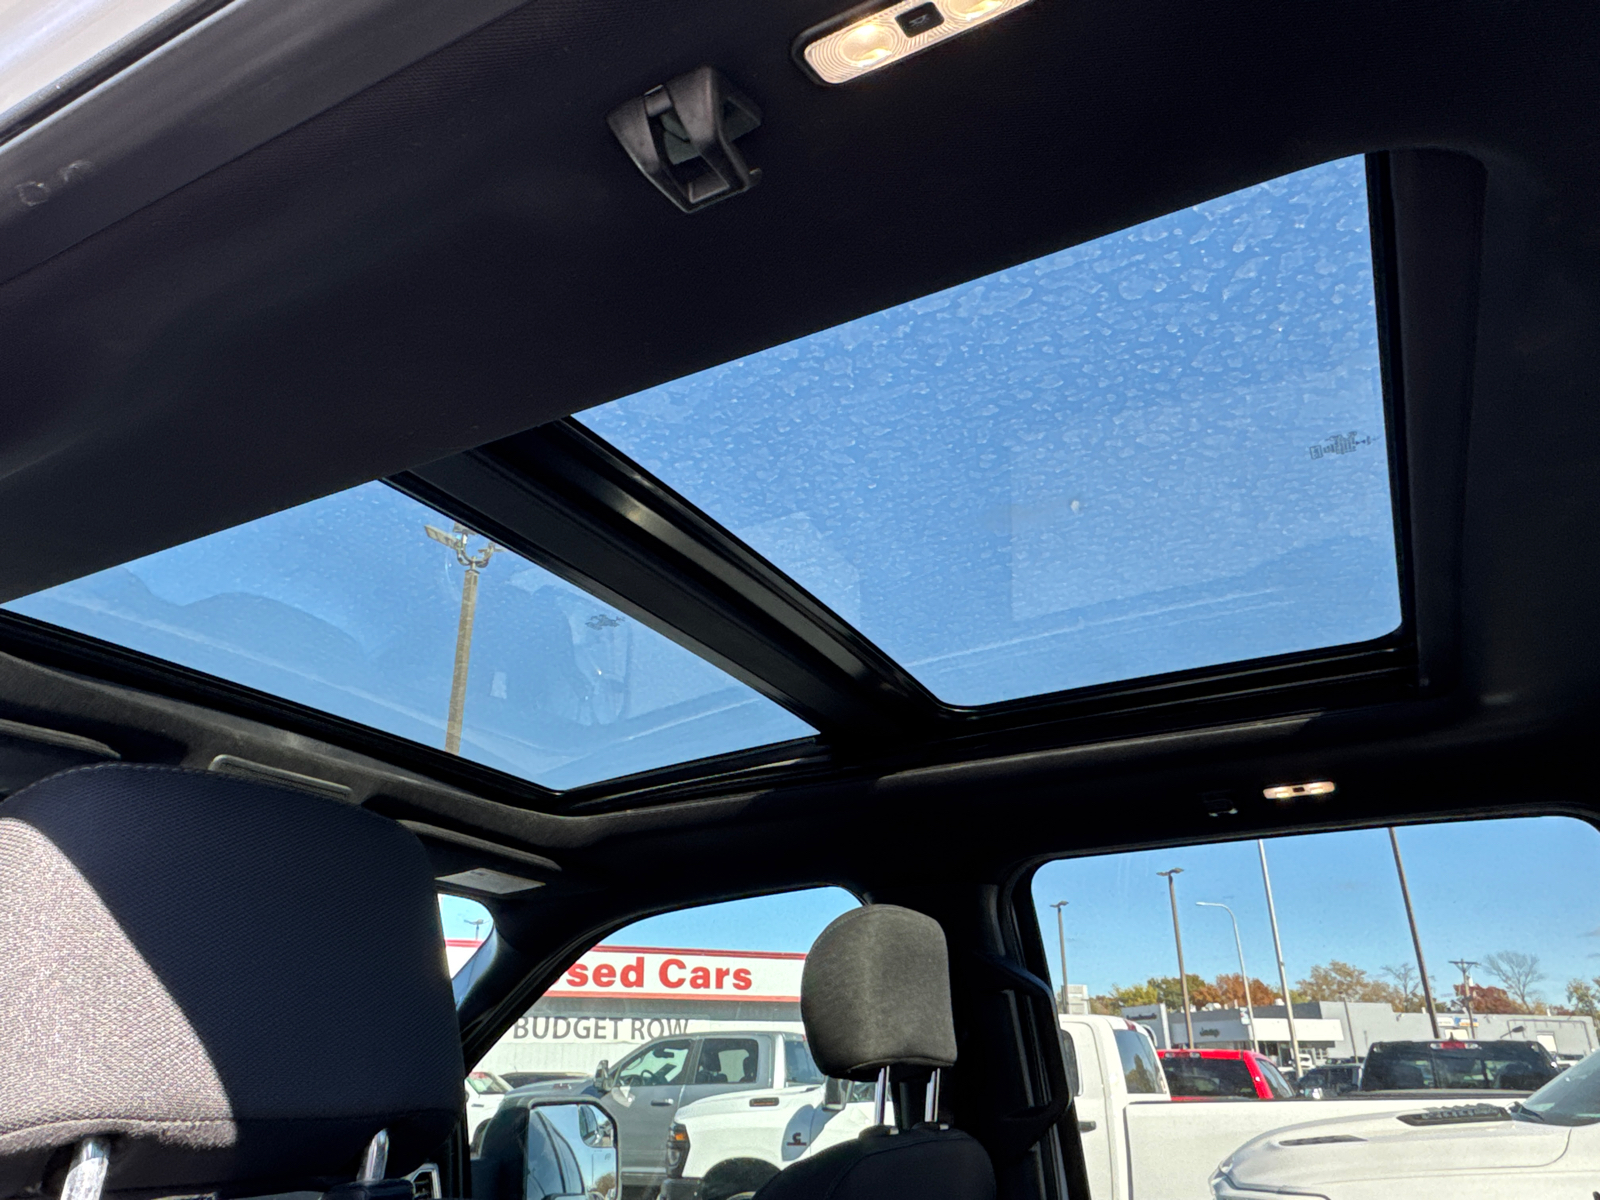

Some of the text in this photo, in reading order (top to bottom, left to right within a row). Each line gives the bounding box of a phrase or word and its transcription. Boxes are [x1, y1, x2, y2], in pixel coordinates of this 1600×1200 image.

[554, 956, 752, 990] sed Cars
[513, 1016, 689, 1040] BUDGET ROW
